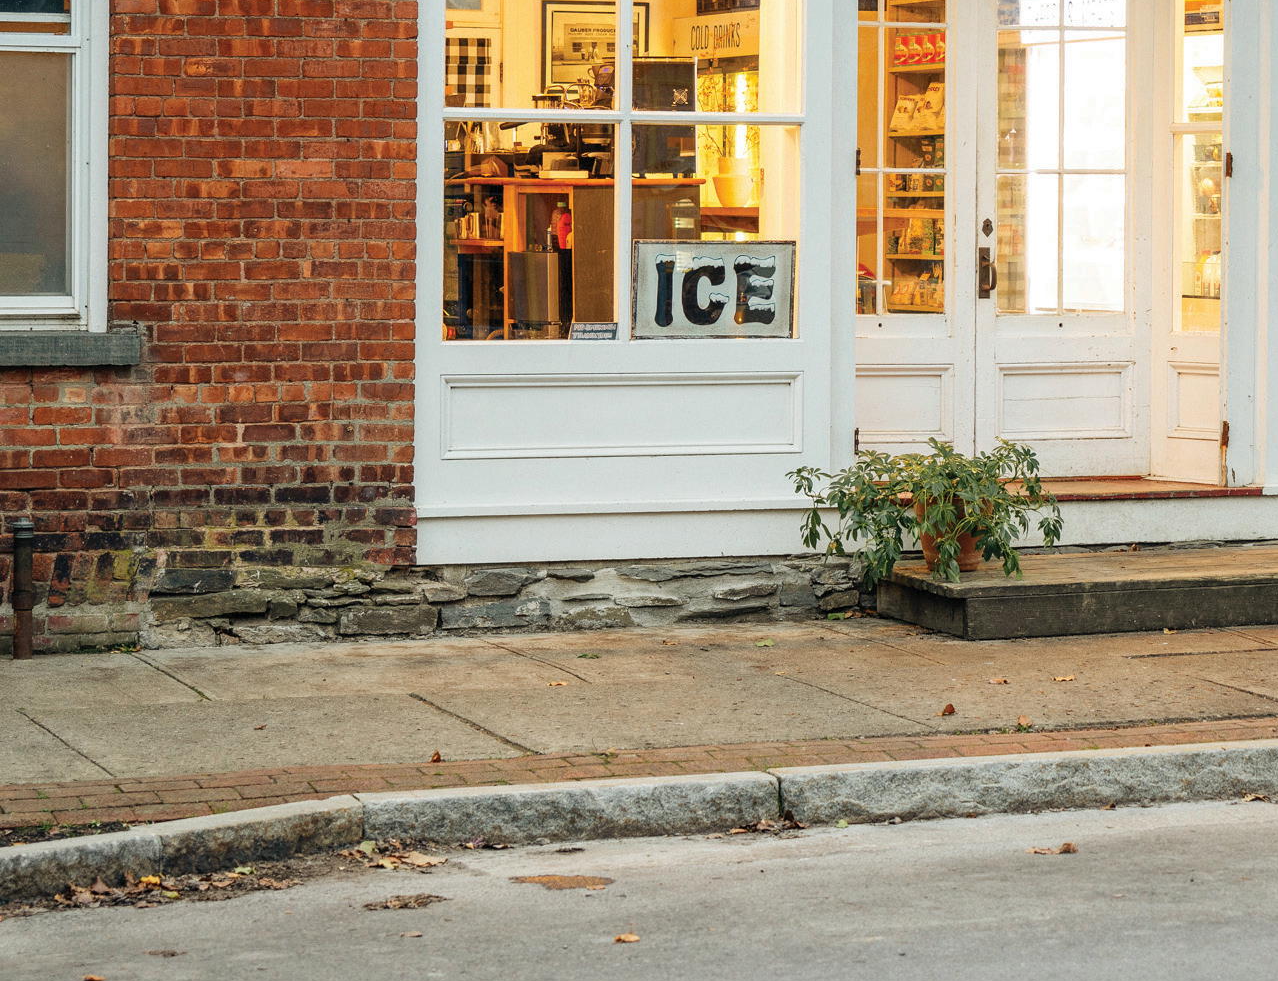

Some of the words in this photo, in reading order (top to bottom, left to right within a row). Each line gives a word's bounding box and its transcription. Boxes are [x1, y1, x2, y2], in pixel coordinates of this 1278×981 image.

[690, 25, 710, 51] COLD
[713, 22, 741, 50] DRINKS
[654, 253, 777, 328] ICE
